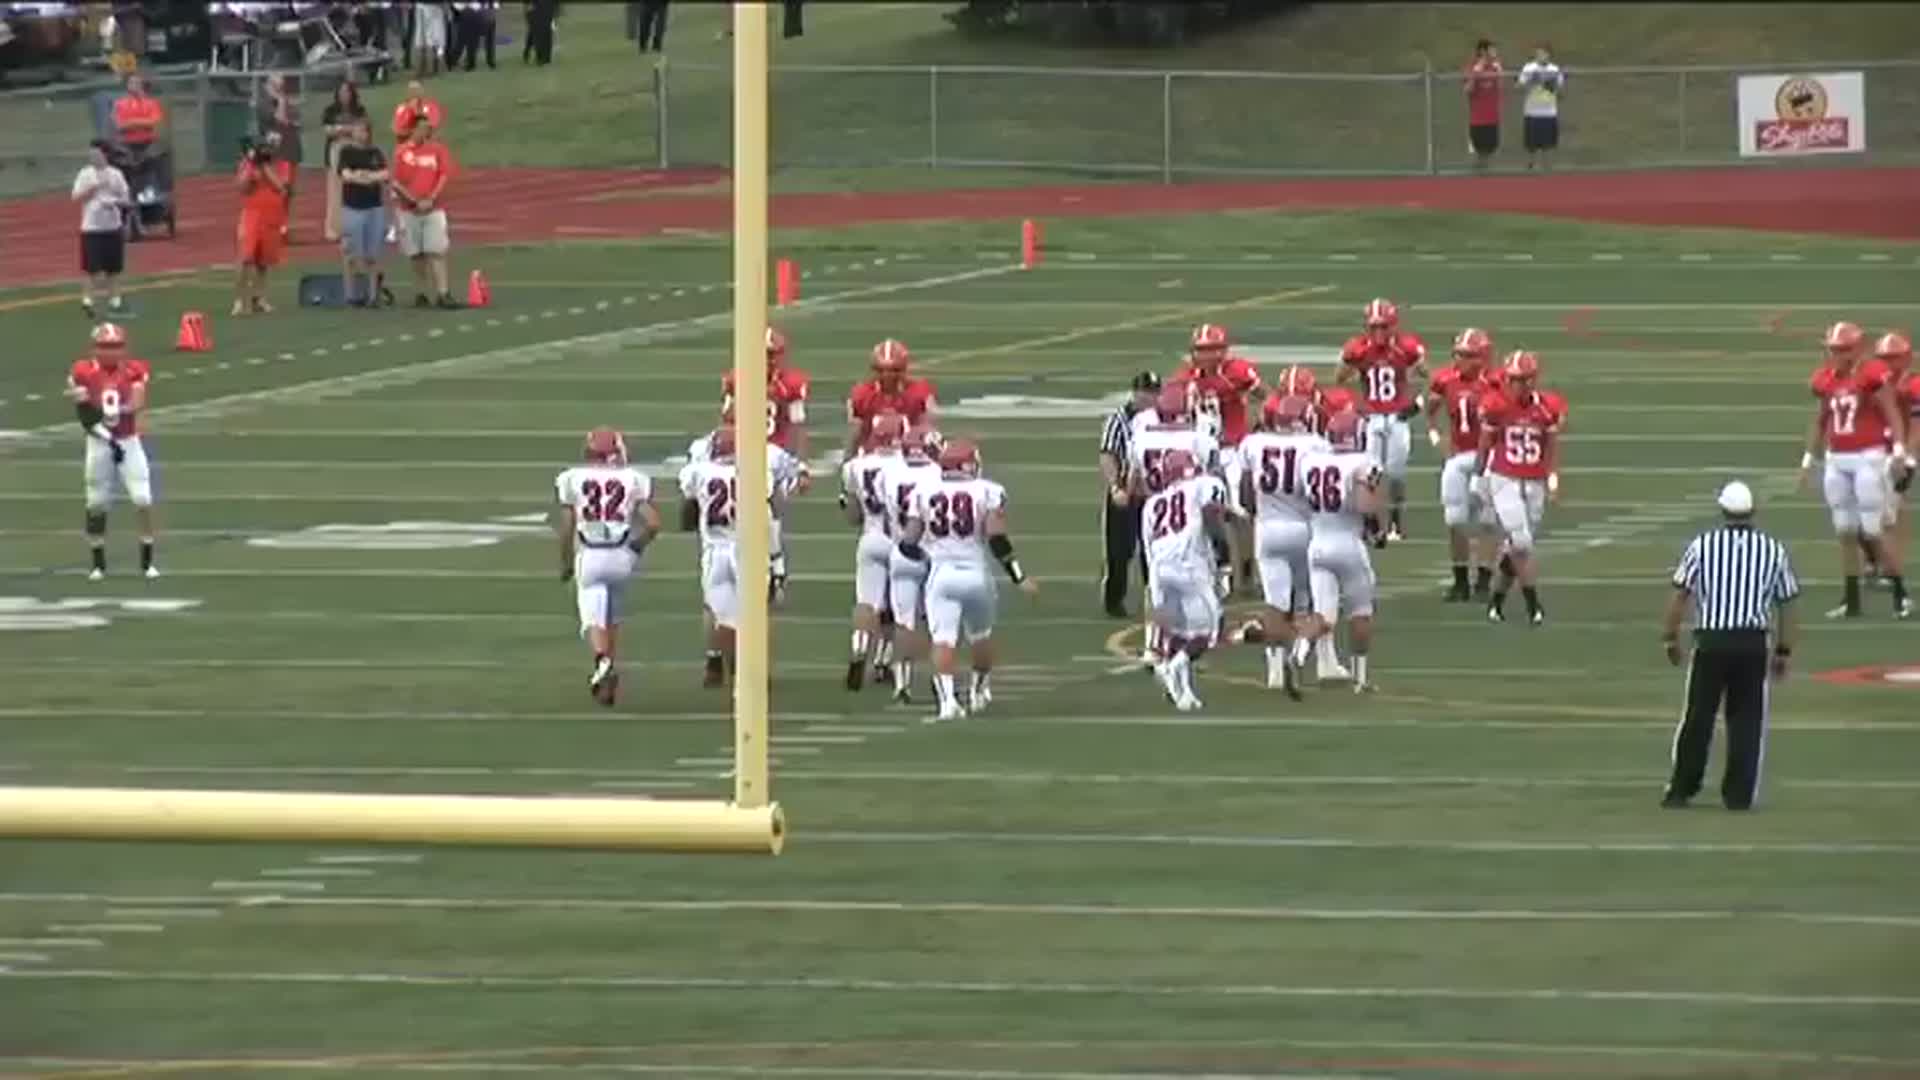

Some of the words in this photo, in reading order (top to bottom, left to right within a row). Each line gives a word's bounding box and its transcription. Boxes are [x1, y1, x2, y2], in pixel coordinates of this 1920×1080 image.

[1367, 366, 1396, 402] 18
[1457, 396, 1470, 433] 1
[1830, 395, 1857, 435] 17
[1505, 425, 1541, 464] 55
[1260, 446, 1298, 494] 51
[1307, 465, 1342, 513] 36
[582, 478, 626, 522] 32
[707, 477, 736, 527] 2
[929, 490, 975, 538] 39
[1152, 490, 1187, 539] 28
